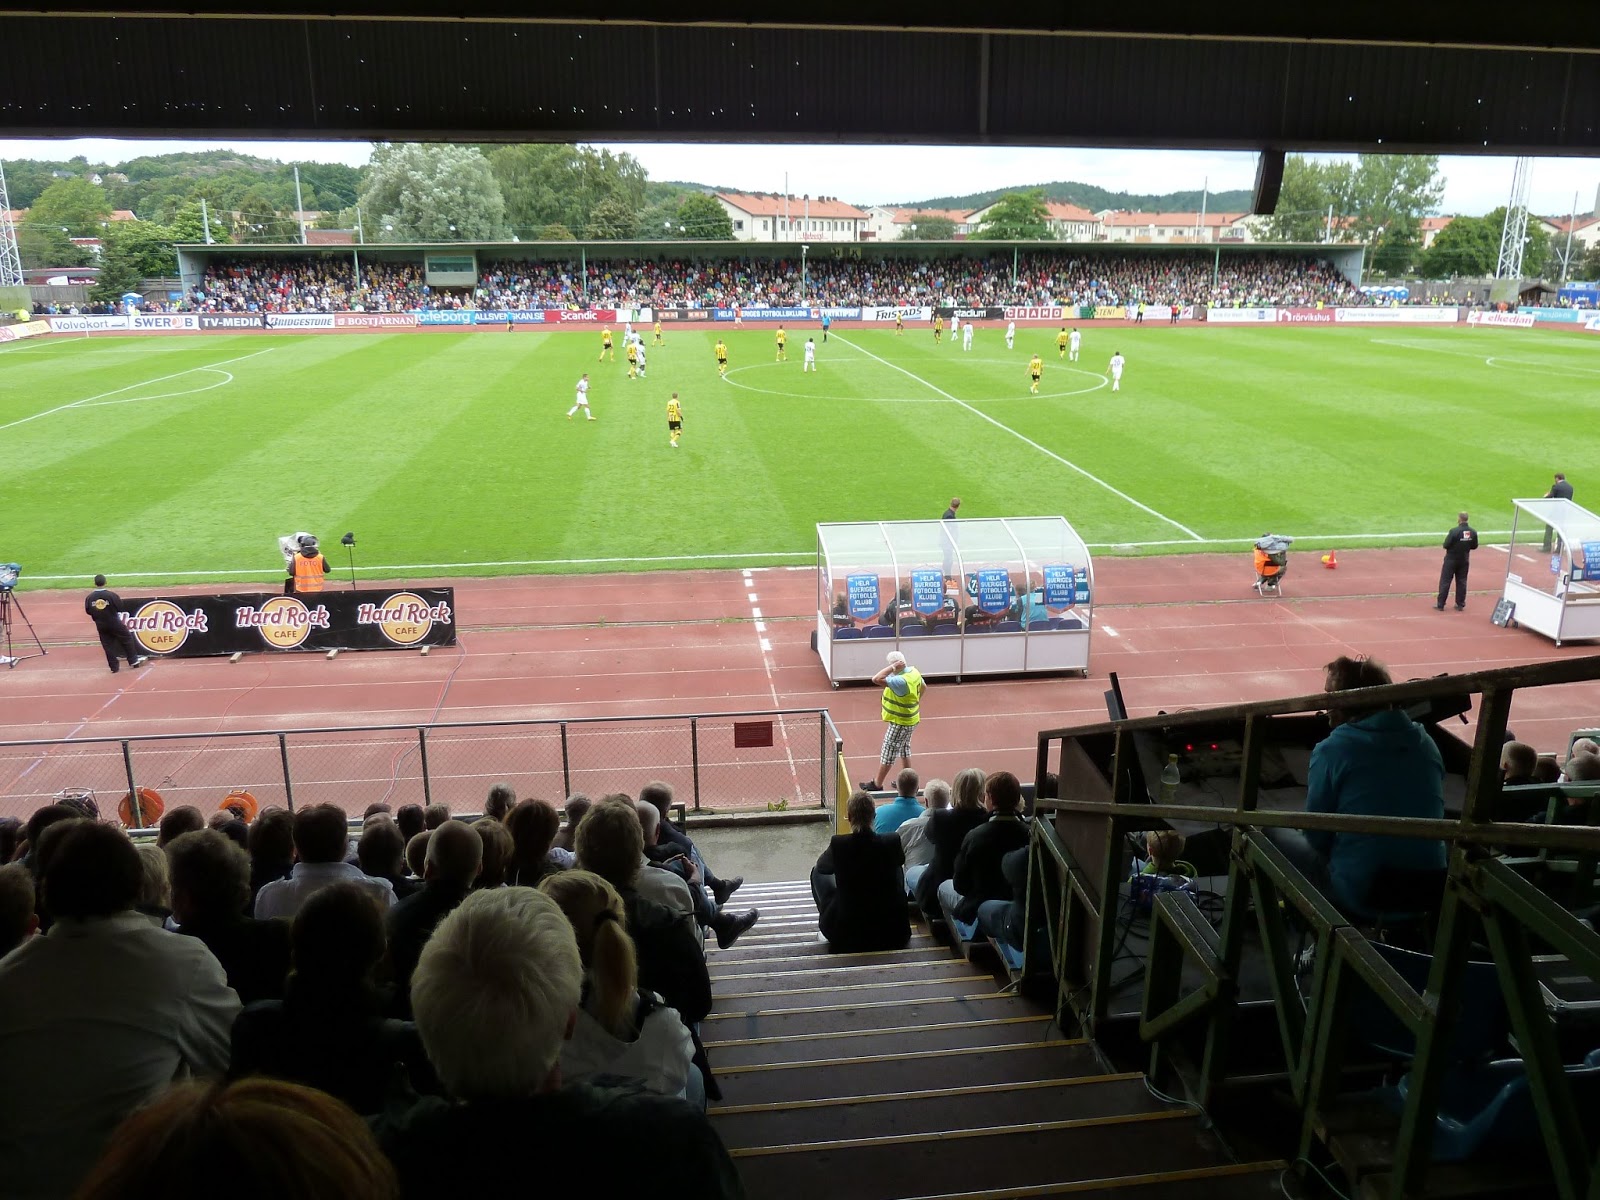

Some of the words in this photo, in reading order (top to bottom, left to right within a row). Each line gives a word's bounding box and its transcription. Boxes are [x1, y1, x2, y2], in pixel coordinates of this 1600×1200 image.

[561, 310, 598, 321] Scandic
[953, 309, 986, 317] stadium
[1006, 308, 1061, 318] CRAMO
[203, 318, 262, 327] TV-MEDIA
[271, 318, 333, 327] BRIDGESTONE
[236, 606, 284, 627] Hard
[286, 605, 330, 629] Rock
[358, 604, 405, 624] Hard
[407, 601, 451, 625] Rock
[162, 608, 208, 633] Rock
[395, 627, 418, 635] CAFE
[151, 635, 174, 644] CAFE
